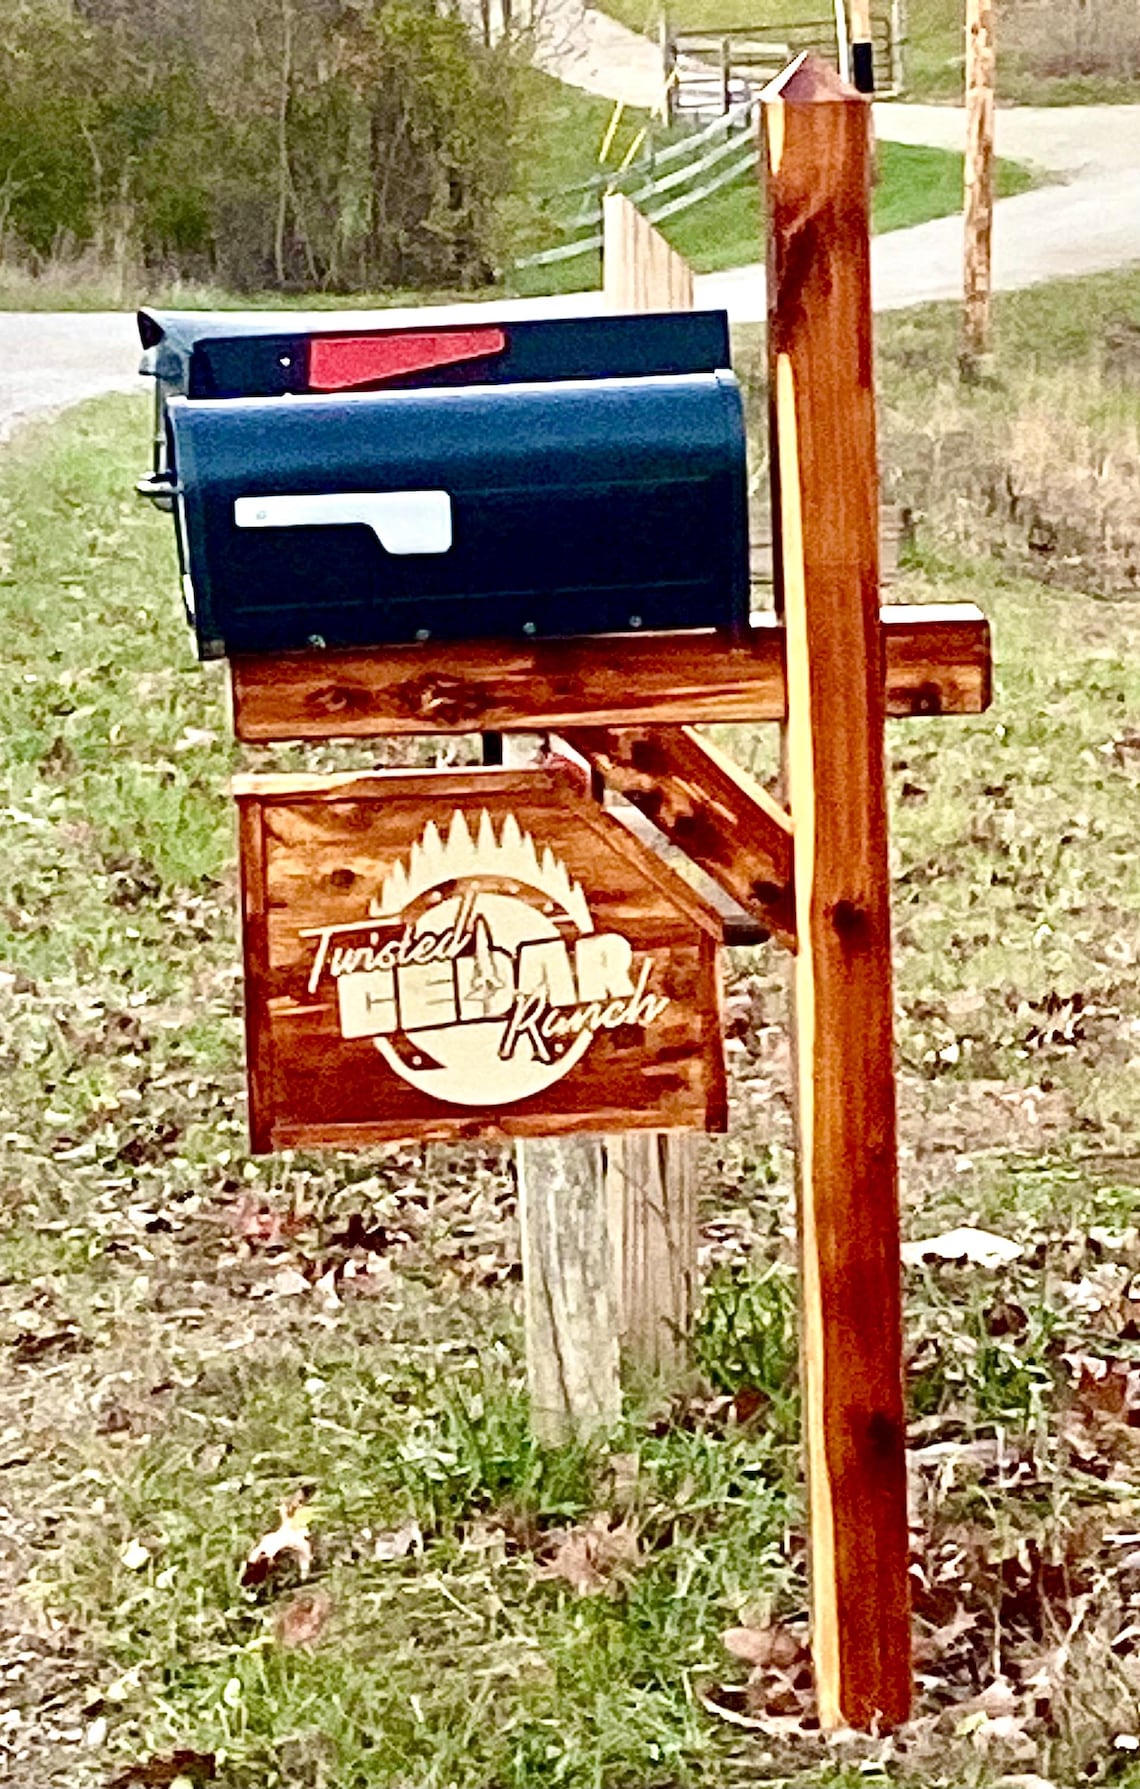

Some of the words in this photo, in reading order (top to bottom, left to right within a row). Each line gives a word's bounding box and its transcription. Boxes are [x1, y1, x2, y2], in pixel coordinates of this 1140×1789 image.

[299, 886, 478, 994] Twisted
[337, 932, 635, 1039] CEDAR
[500, 957, 670, 1061] Ranch
